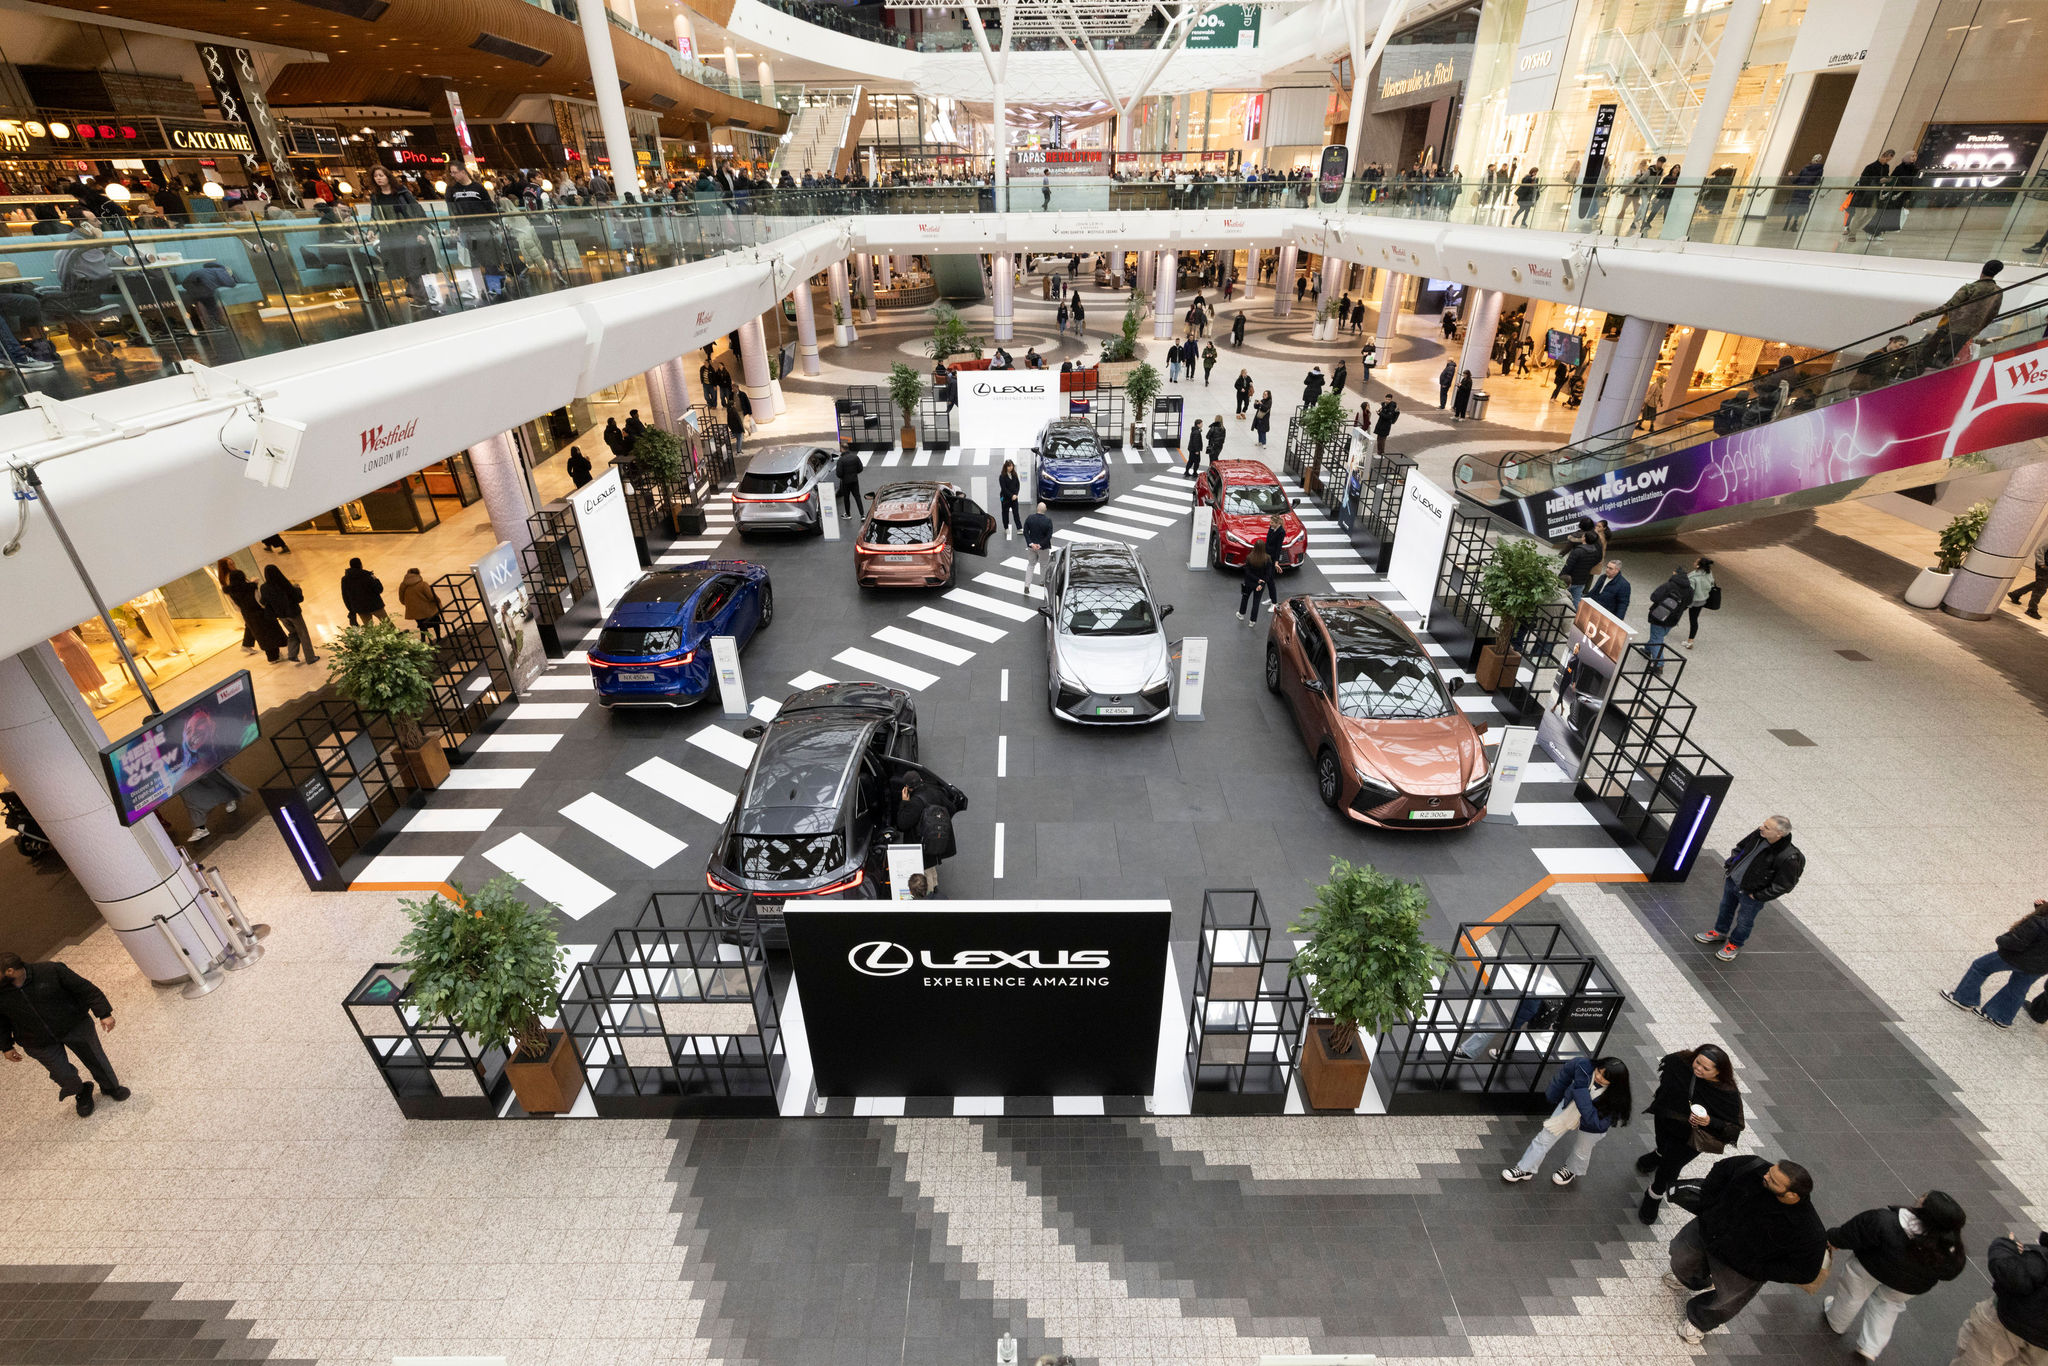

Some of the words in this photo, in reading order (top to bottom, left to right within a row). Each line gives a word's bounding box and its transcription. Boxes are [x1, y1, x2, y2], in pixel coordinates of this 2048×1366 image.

[1195, 14, 1225, 27] 00%
[1520, 49, 1552, 72] OYSHO
[1828, 54, 1838, 63] Lift
[1838, 52, 1854, 63] Lobby
[1853, 51, 1859, 60] 2
[1424, 70, 1432, 88] &
[1432, 57, 1454, 87] Fitch
[1598, 113, 1605, 122] 2
[174, 130, 226, 150] CATCH
[229, 134, 252, 151] ME
[402, 150, 427, 163] Pho
[1528, 263, 1552, 278] Westfield
[2005, 359, 2048, 389] Wes
[993, 385, 1045, 393] LEXUS
[360, 417, 419, 456] Westfield
[363, 452, 394, 473] LONDON
[396, 446, 409, 460] W12
[593, 484, 616, 506] LEXUS
[1545, 491, 1585, 515] HERE
[1585, 484, 1613, 503] WE
[1612, 465, 1669, 497] GLOW
[1418, 494, 1443, 519] LEXUS
[1548, 515, 1564, 525] Discover
[1568, 511, 1578, 520] free
[1604, 500, 1623, 512] light-up
[1631, 489, 1665, 504] installations.
[490, 559, 513, 590] NX
[1582, 621, 1611, 658] RZ
[120, 731, 166, 764] HERE
[123, 754, 154, 775] WE
[127, 747, 178, 787] GLOW
[130, 783, 150, 798] Discover
[920, 950, 1110, 969] LEXUS
[924, 977, 1026, 987] EXPERIENCE
[1033, 977, 1110, 987] AMAZING
